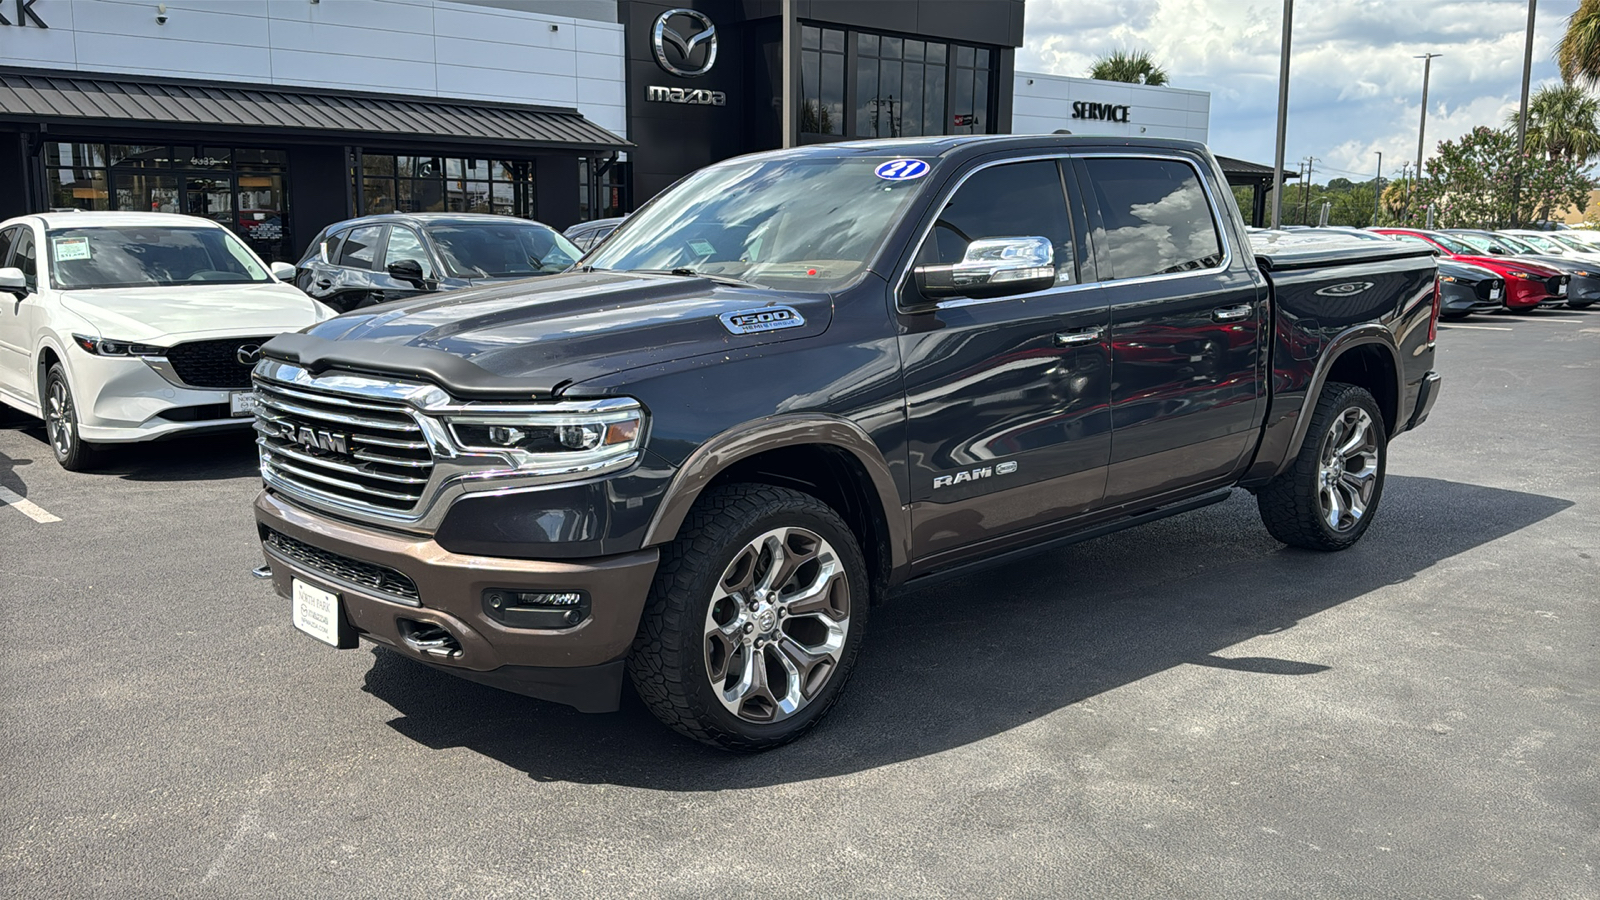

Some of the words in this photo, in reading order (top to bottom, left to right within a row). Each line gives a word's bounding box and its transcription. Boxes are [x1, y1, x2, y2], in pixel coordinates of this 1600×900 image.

[0, 0, 49, 29] K
[646, 85, 727, 107] mazda
[1071, 101, 1131, 123] SERVICE
[881, 161, 921, 177] 21
[732, 310, 790, 326] 1500
[275, 419, 348, 454] RAM
[933, 466, 992, 489] RAM
[298, 590, 315, 607] NORTH
[316, 598, 330, 613] PARK
